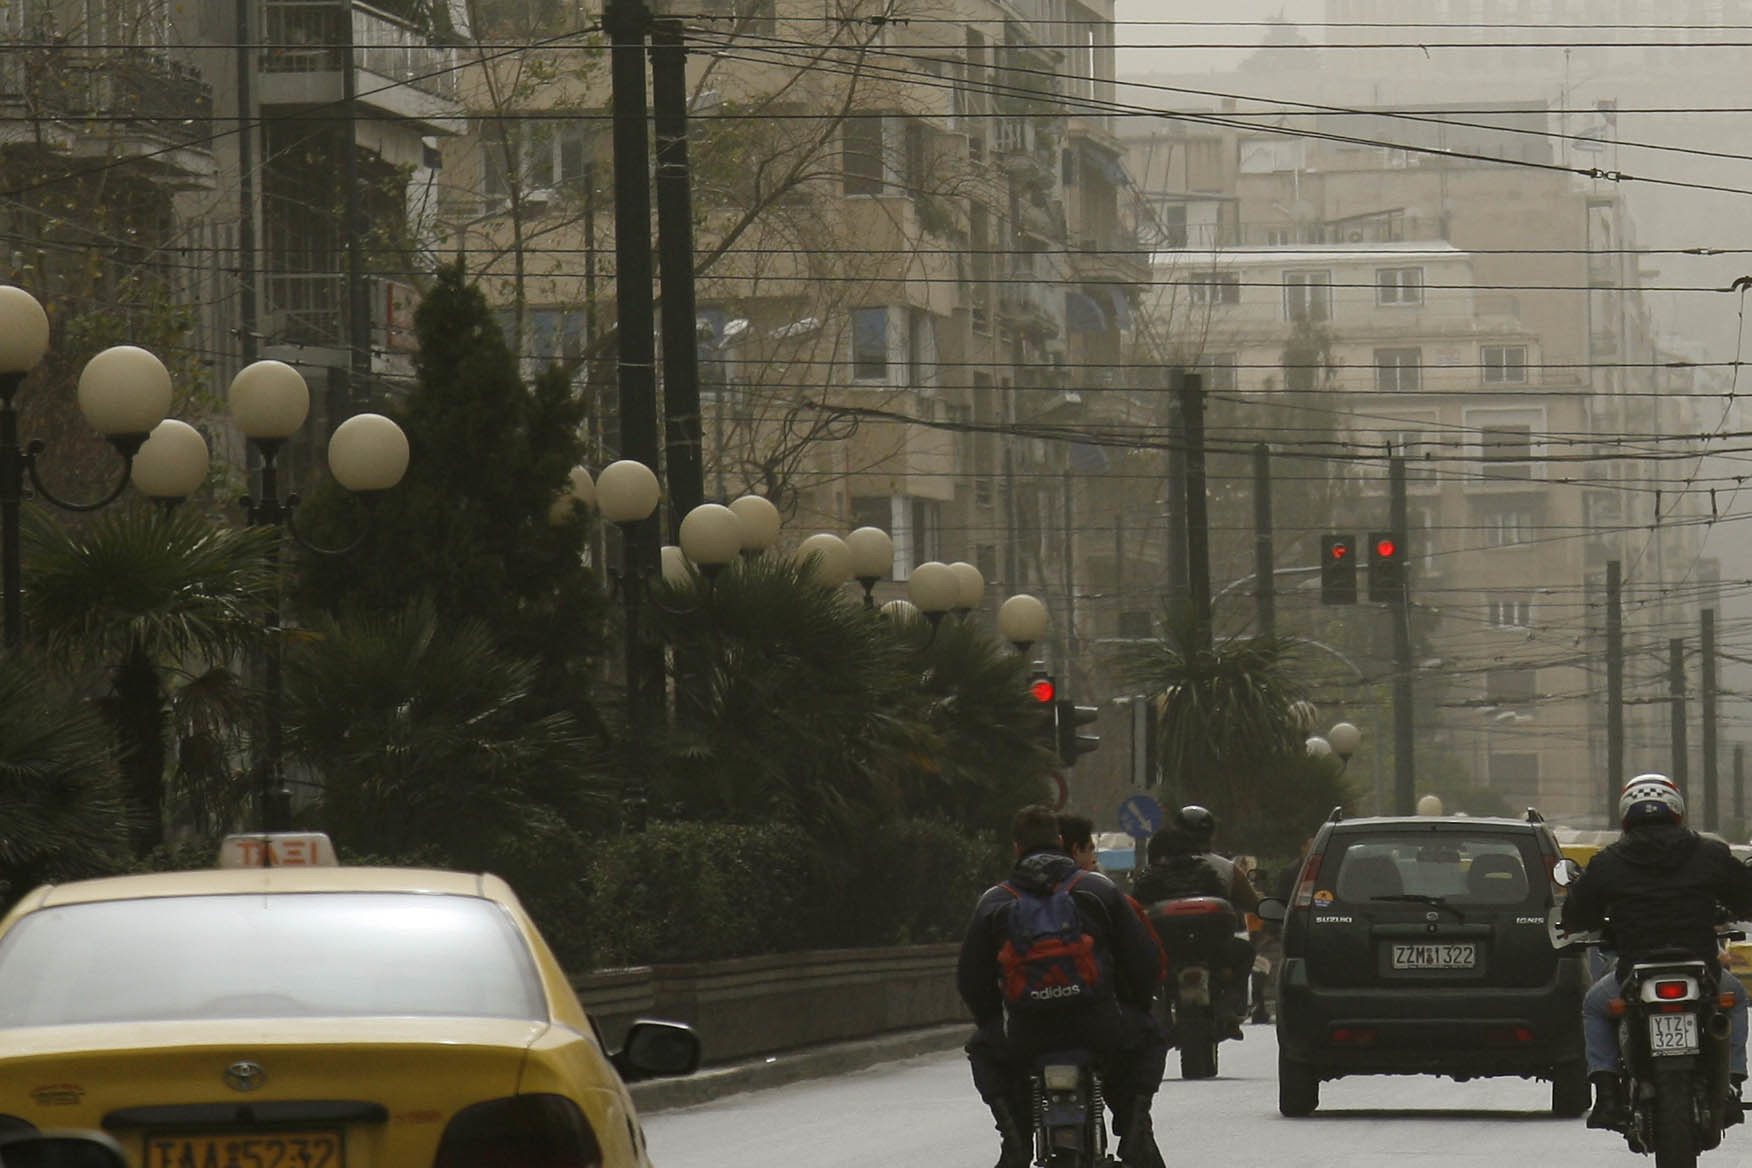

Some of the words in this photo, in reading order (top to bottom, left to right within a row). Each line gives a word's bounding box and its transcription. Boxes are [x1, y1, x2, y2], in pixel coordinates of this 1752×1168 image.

[1315, 916, 1353, 924] SUZUKI
[1030, 984, 1081, 1000] adidas
[1654, 1016, 1683, 1033] YTZ
[1655, 1032, 1684, 1048] 322
